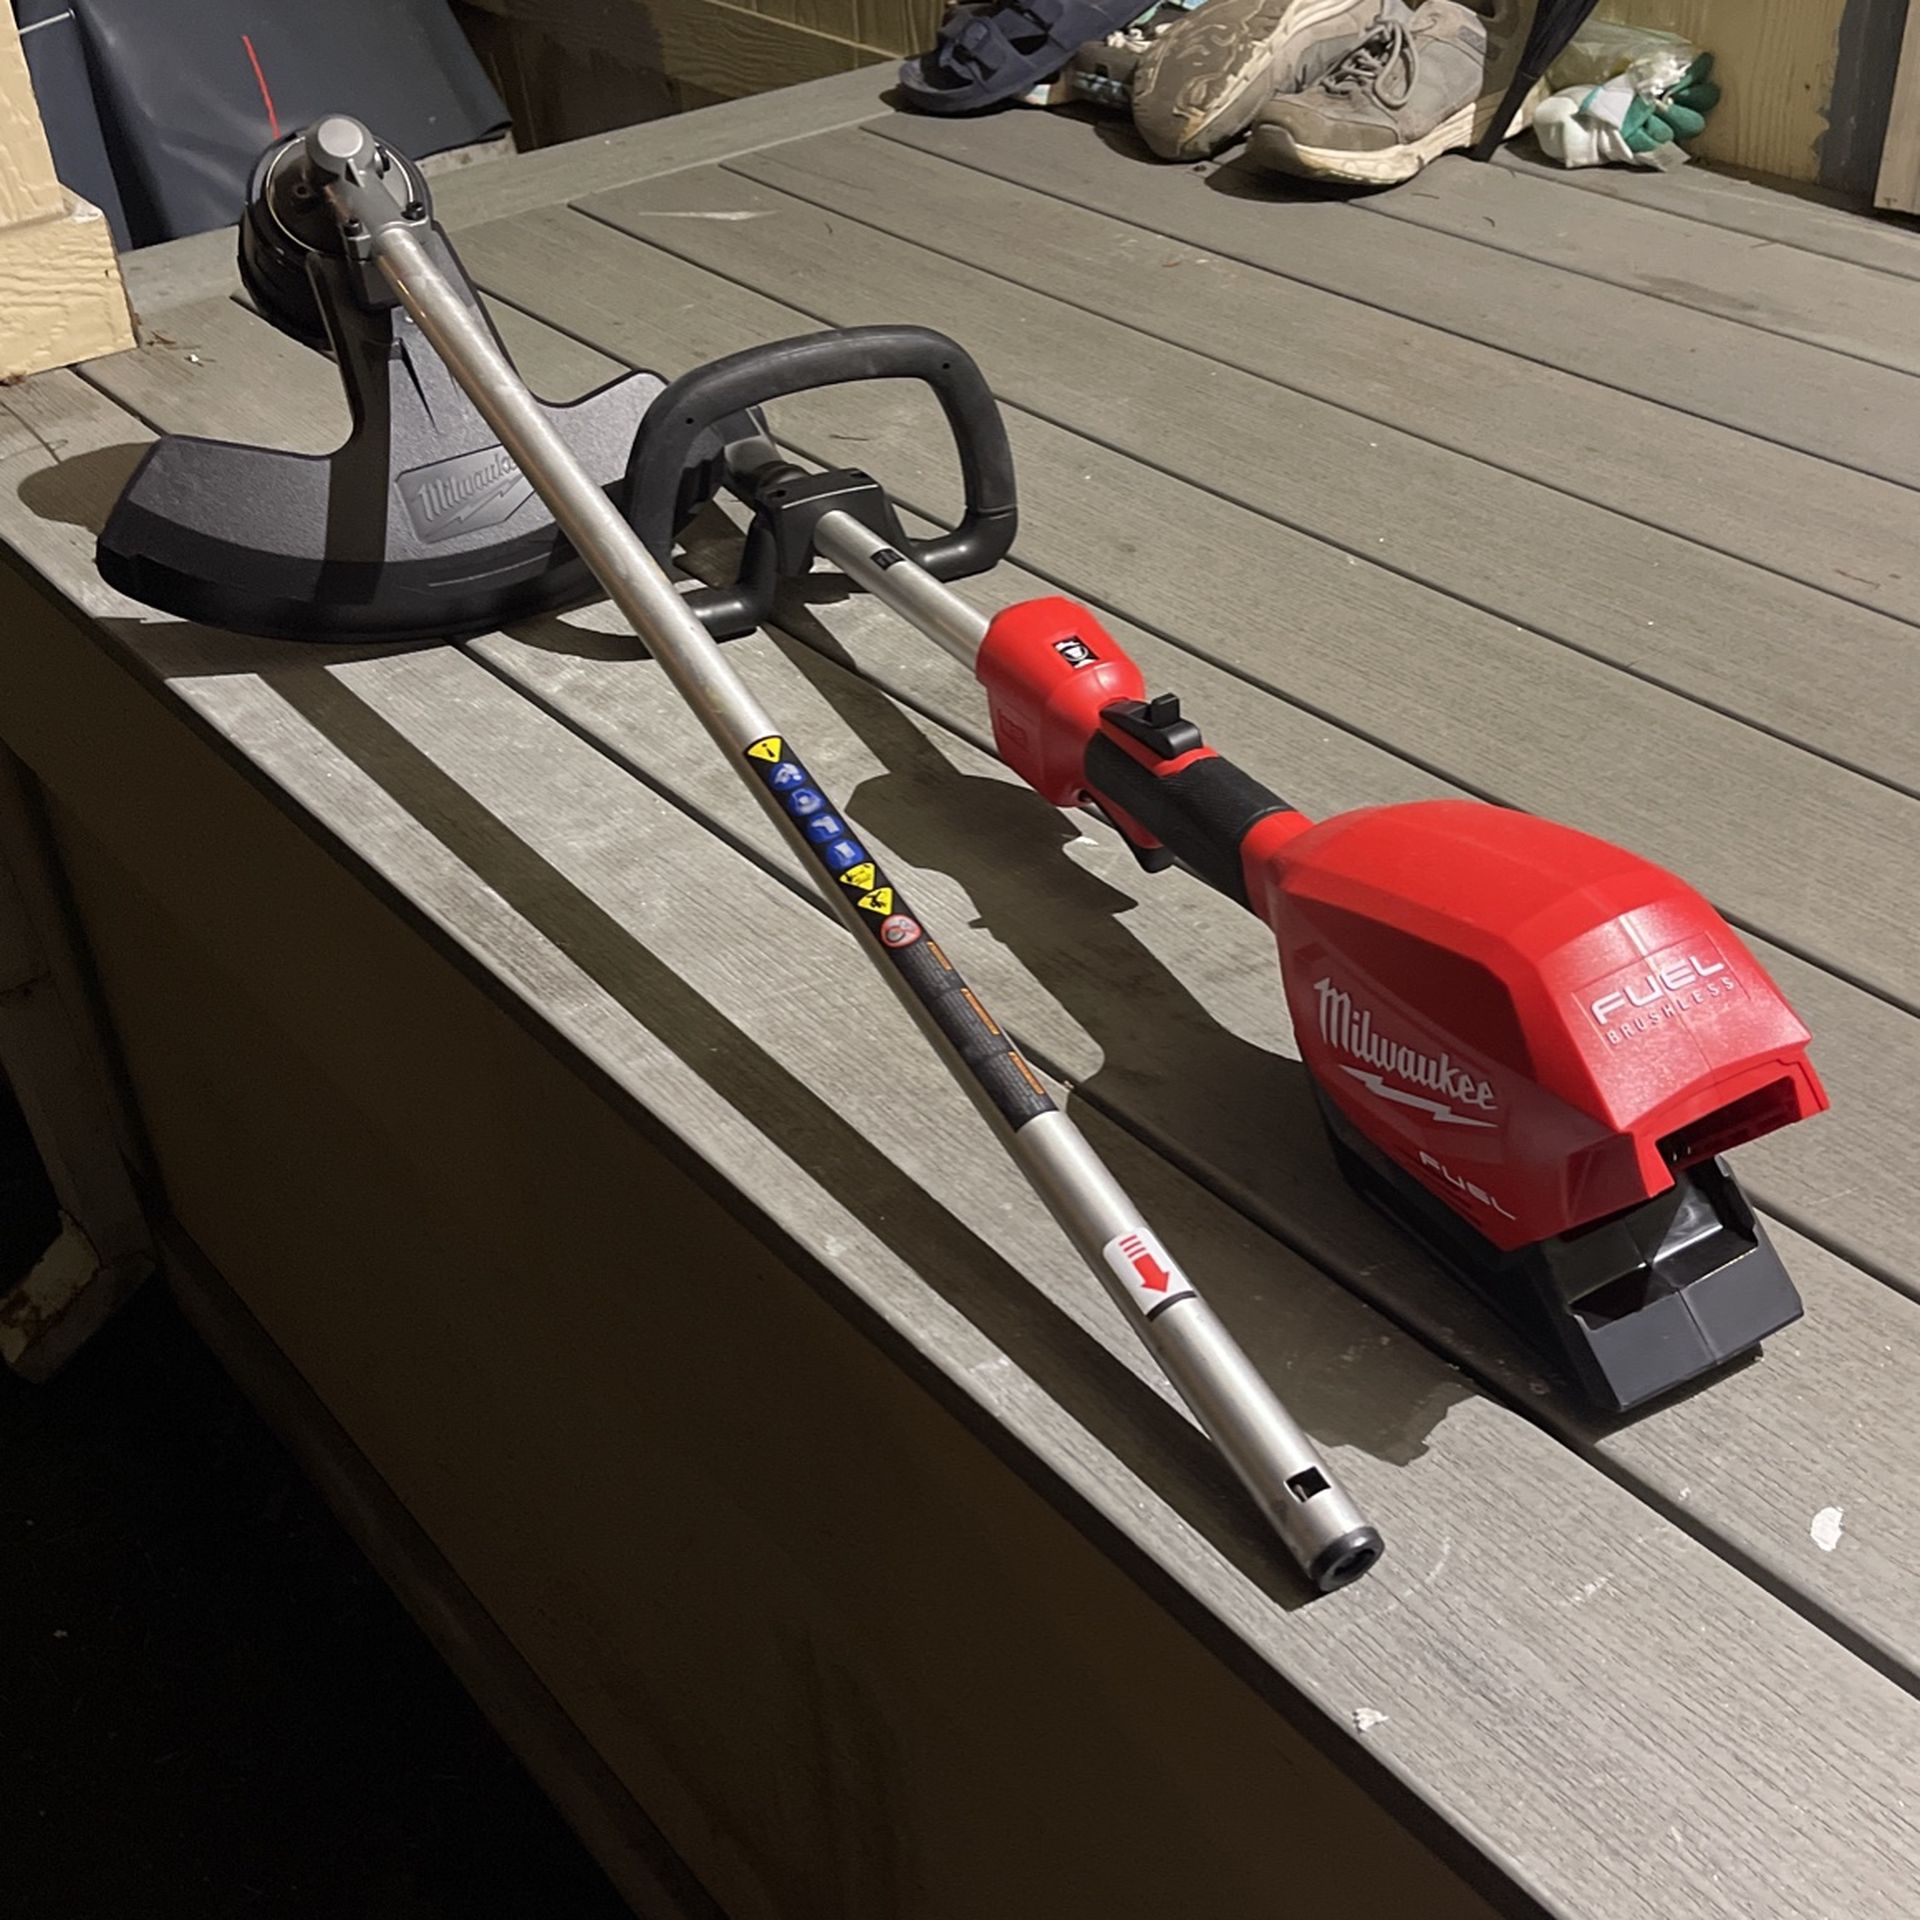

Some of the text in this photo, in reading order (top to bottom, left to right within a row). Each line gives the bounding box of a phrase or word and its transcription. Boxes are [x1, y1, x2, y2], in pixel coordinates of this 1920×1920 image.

[418, 453, 519, 522] Milwauk
[1591, 955, 1725, 1025] FUEL
[1605, 977, 1735, 1044] BRUSHLESS
[1314, 977, 1498, 1109] Milwaukee
[1419, 1151, 1516, 1220] FUEL
